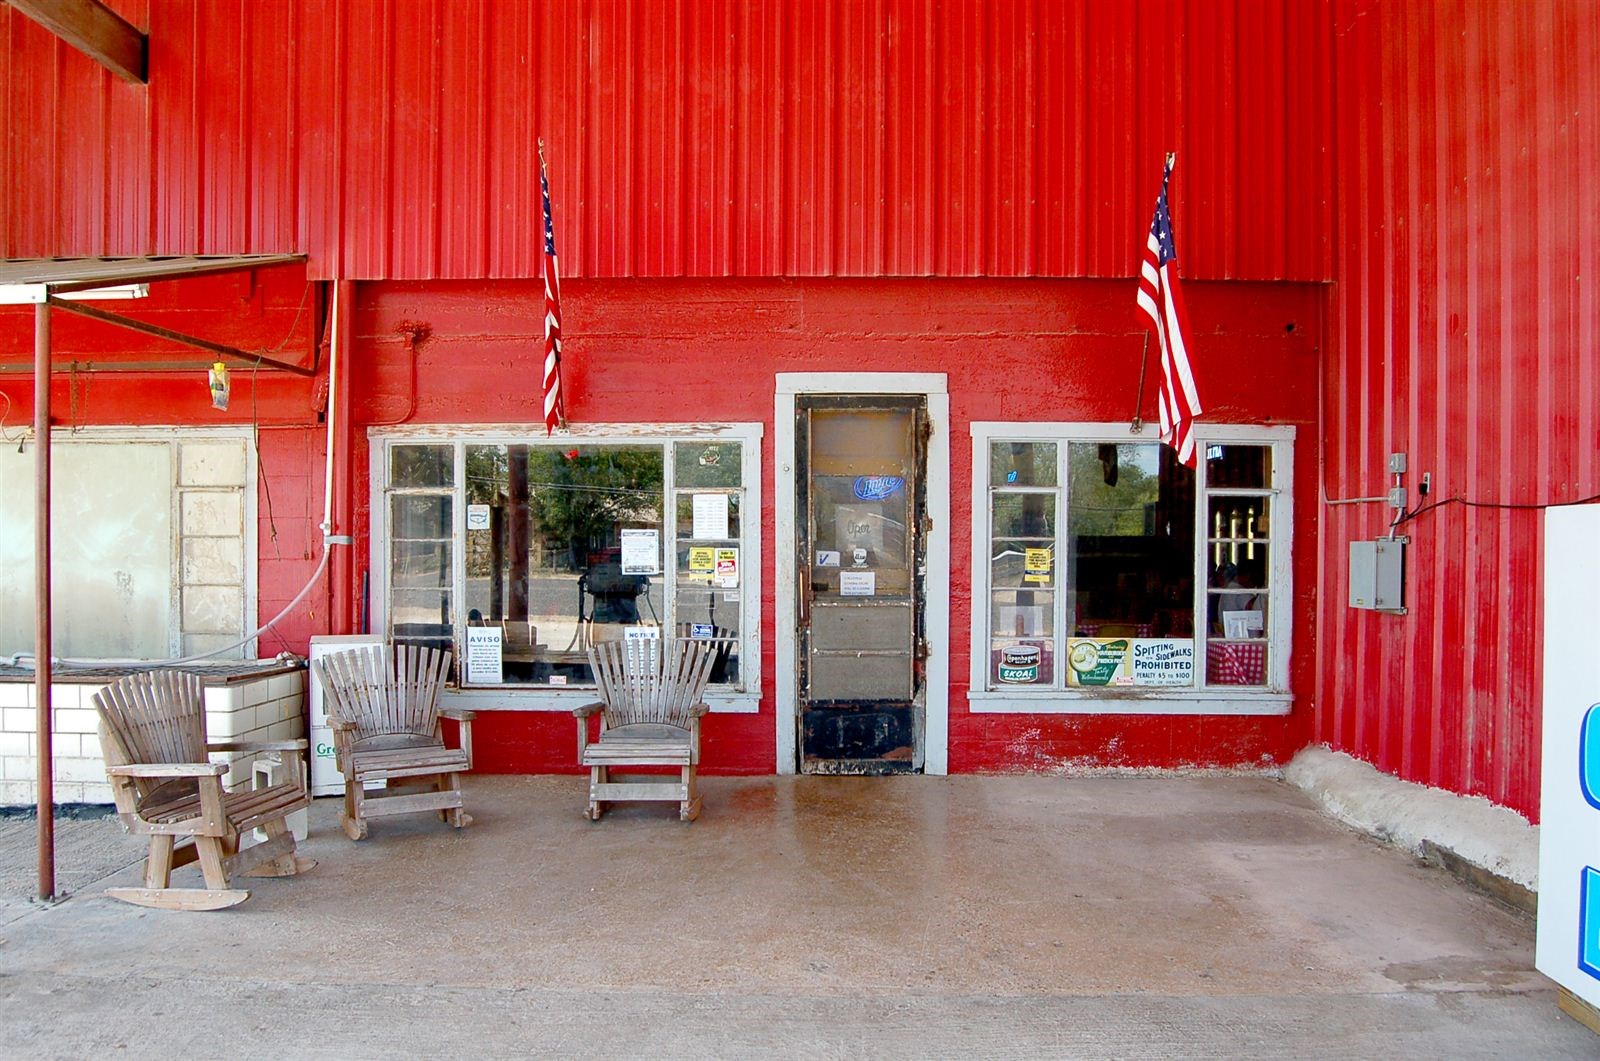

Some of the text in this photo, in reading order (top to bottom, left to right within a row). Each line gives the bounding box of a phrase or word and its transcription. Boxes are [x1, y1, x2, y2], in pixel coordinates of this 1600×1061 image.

[847, 520, 871, 538] Open
[1134, 644, 1174, 657] SPITTING
[1156, 648, 1192, 661] SIDEWALKS
[1135, 659, 1192, 670] PROHIBITED
[1003, 669, 1034, 678] SKOAL
